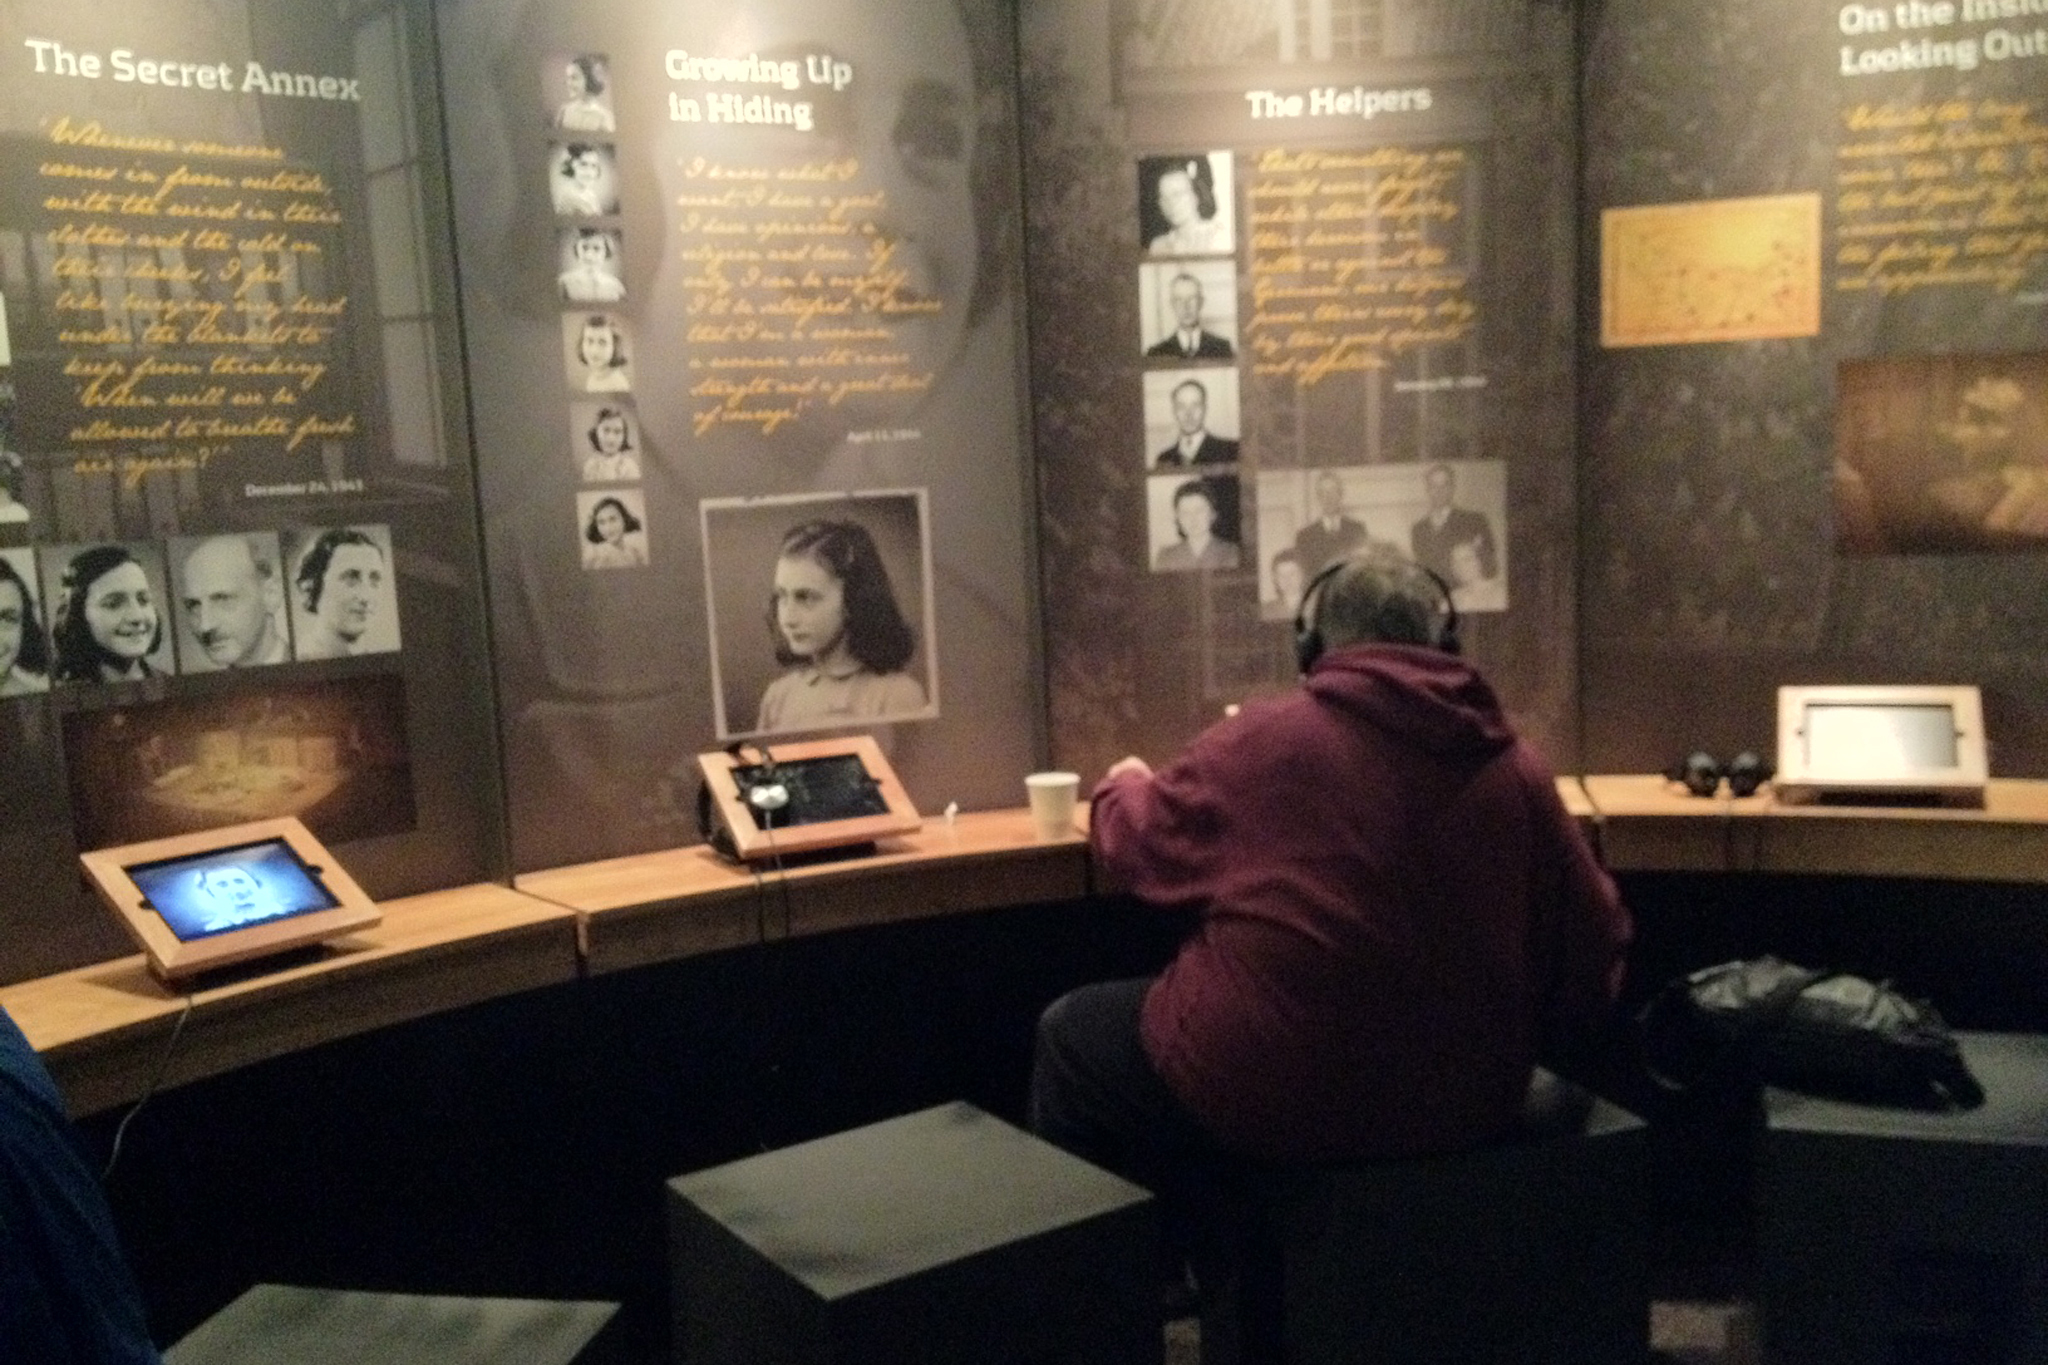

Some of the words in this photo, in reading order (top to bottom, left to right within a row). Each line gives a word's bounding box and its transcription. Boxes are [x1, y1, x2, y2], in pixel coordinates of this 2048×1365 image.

[1838, 4, 1890, 36] On
[1895, 2, 1955, 29] the
[25, 37, 101, 79] The
[110, 49, 235, 92] Secret
[240, 61, 361, 101] Annex
[665, 49, 801, 91] Growing
[805, 54, 853, 91] Up
[1840, 38, 1979, 77] Looking
[1984, 28, 2048, 61] Out
[705, 93, 814, 131] Hiding
[1245, 90, 1303, 119] The
[1308, 85, 1433, 120] Helpers
[156, 166, 232, 200] from
[121, 193, 158, 215] the
